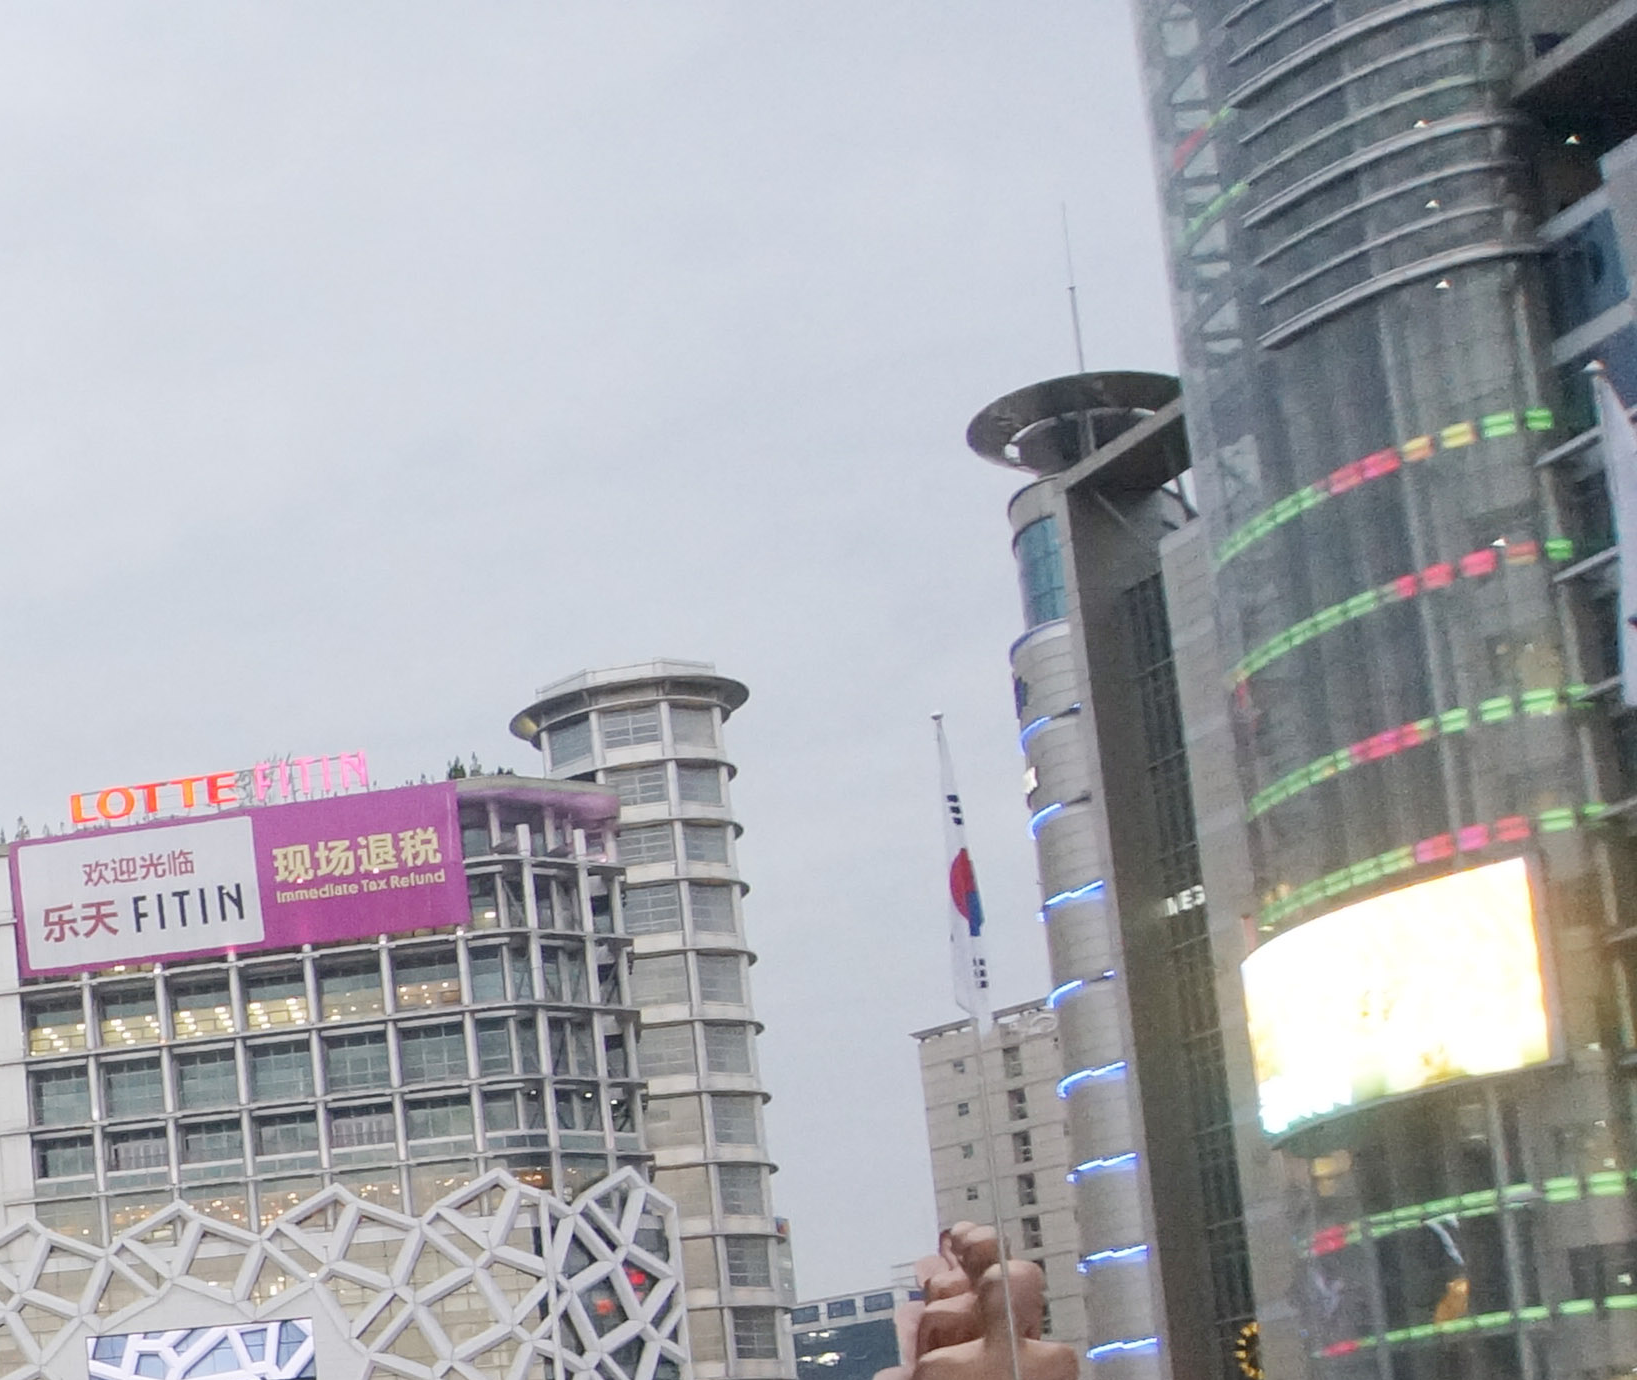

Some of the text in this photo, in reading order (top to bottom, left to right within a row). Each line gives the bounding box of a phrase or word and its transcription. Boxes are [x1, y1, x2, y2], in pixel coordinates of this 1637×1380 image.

[70, 748, 369, 824] LOTTE FITIN
[82, 849, 195, 887] 欢迎光临
[272, 826, 443, 883] 现场退税
[43, 883, 245, 943] 乐天 FITIN
[276, 868, 446, 904] Immediate Tax Refund
